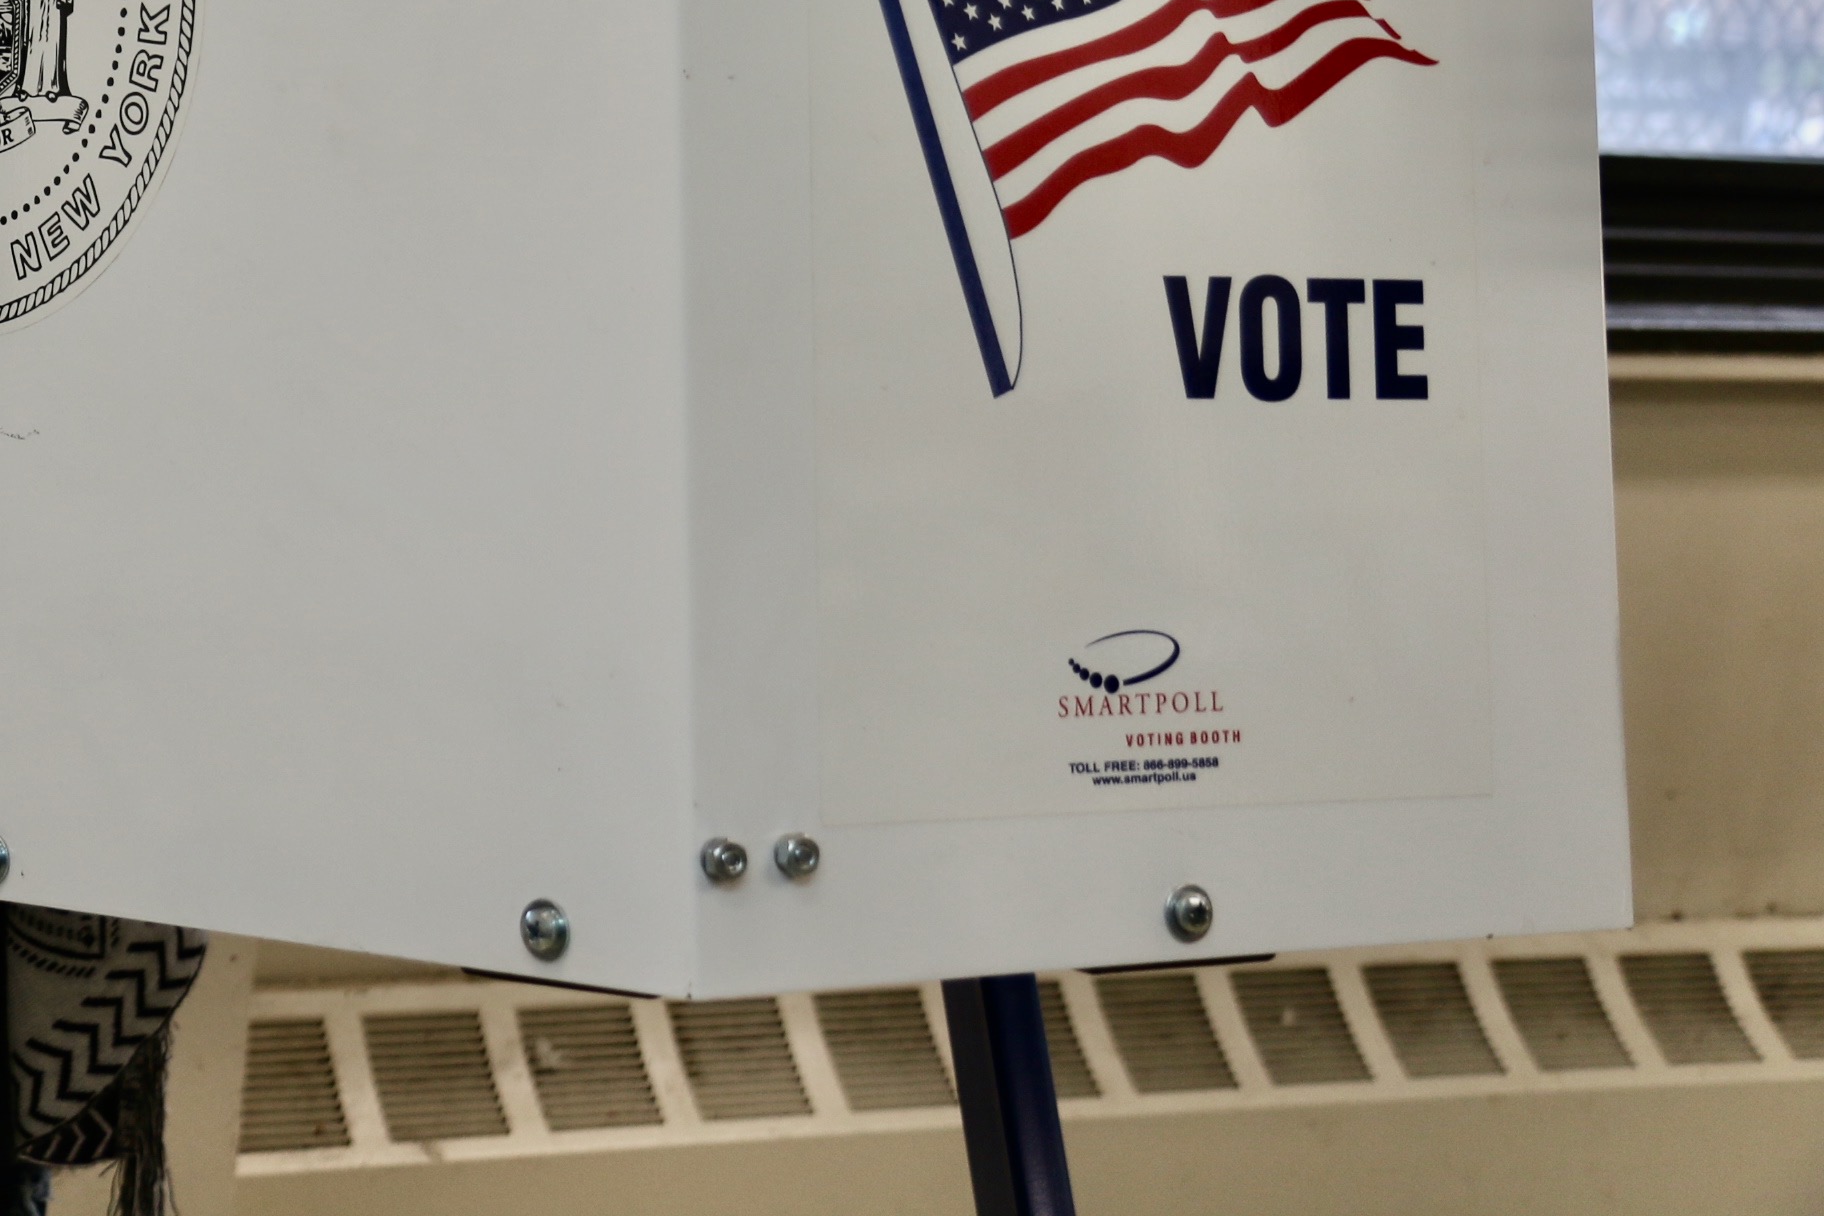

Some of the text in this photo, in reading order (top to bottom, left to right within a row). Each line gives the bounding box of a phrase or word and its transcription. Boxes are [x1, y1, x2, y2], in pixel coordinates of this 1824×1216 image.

[13, 176, 102, 282] NEW
[100, 2, 171, 168] YORK
[1163, 274, 1429, 402] VOTE
[1058, 691, 1224, 718] SMARTPOLL
[1126, 729, 1241, 747] VOTING BOOTH
[1069, 762, 1100, 774] TOLL
[1104, 759, 1140, 772] FREE:
[1092, 771, 1196, 785] www.smartpoll.us
